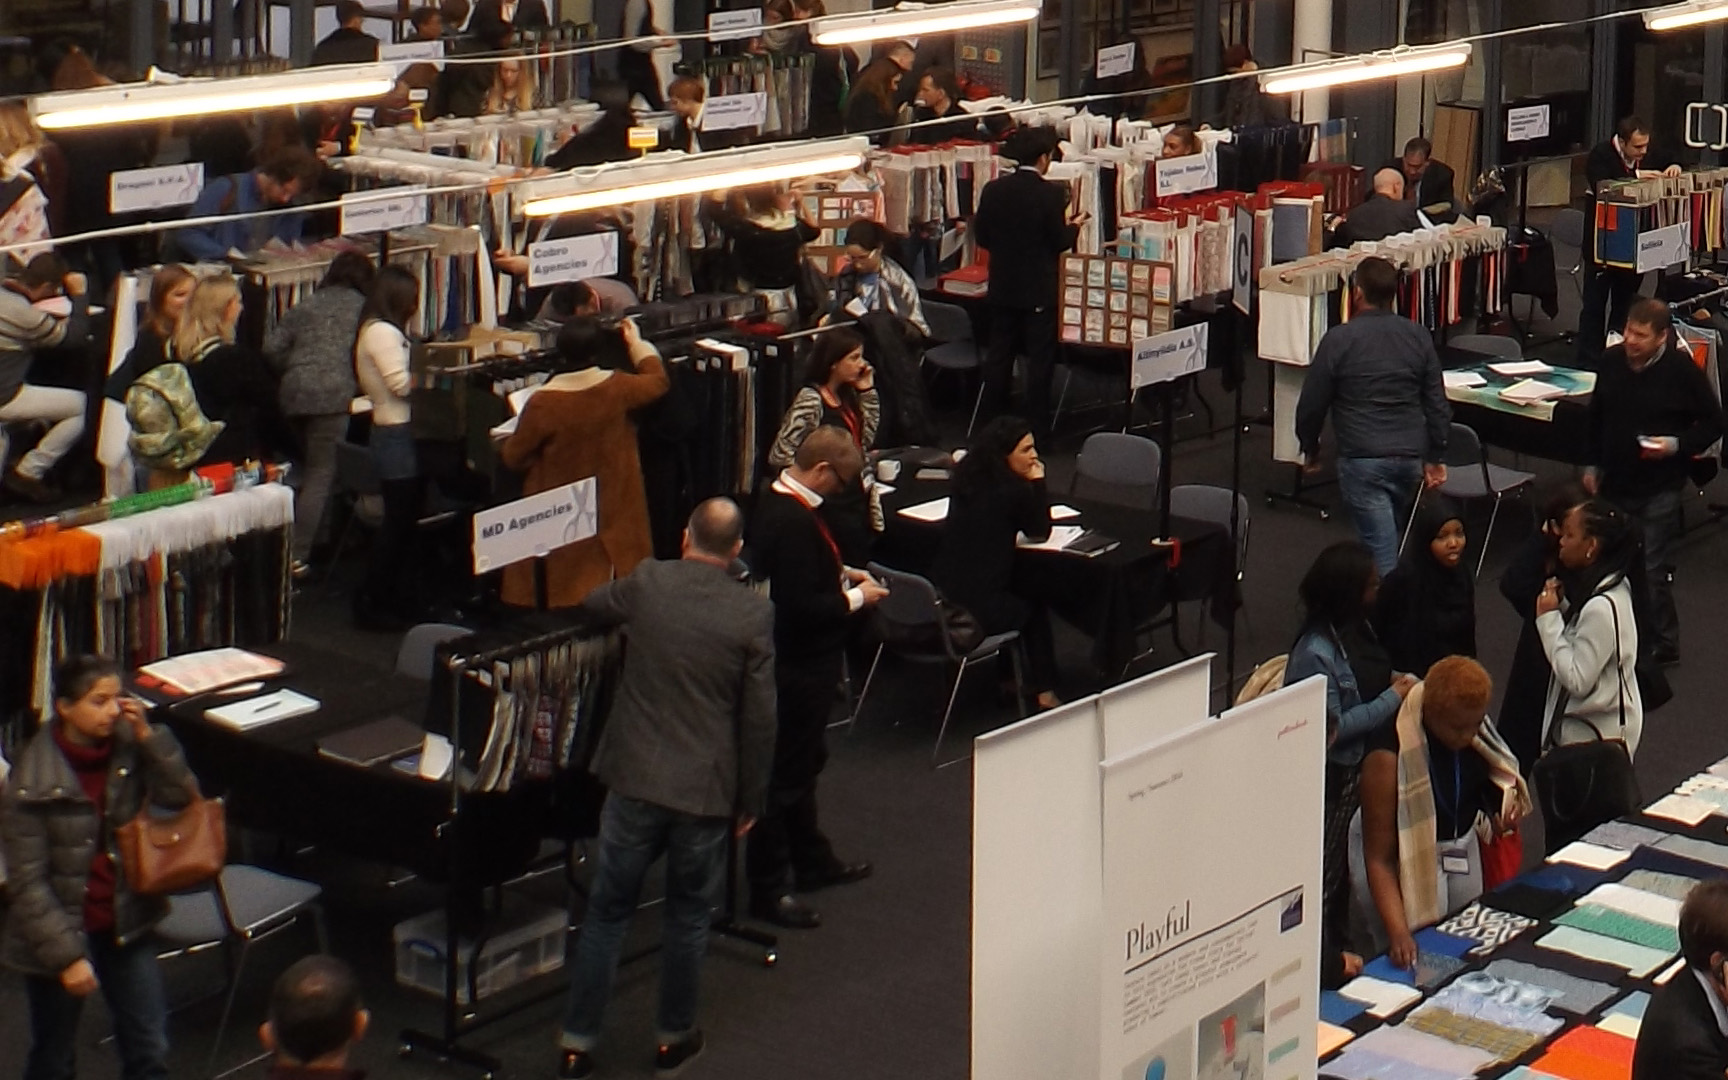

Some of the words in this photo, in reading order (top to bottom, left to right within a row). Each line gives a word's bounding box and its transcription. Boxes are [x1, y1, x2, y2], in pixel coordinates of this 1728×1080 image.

[534, 259, 588, 275] Agencies
[1237, 232, 1249, 288] C
[481, 522, 505, 539] MD
[508, 503, 573, 530] Agencies
[1126, 898, 1191, 961] Playful
